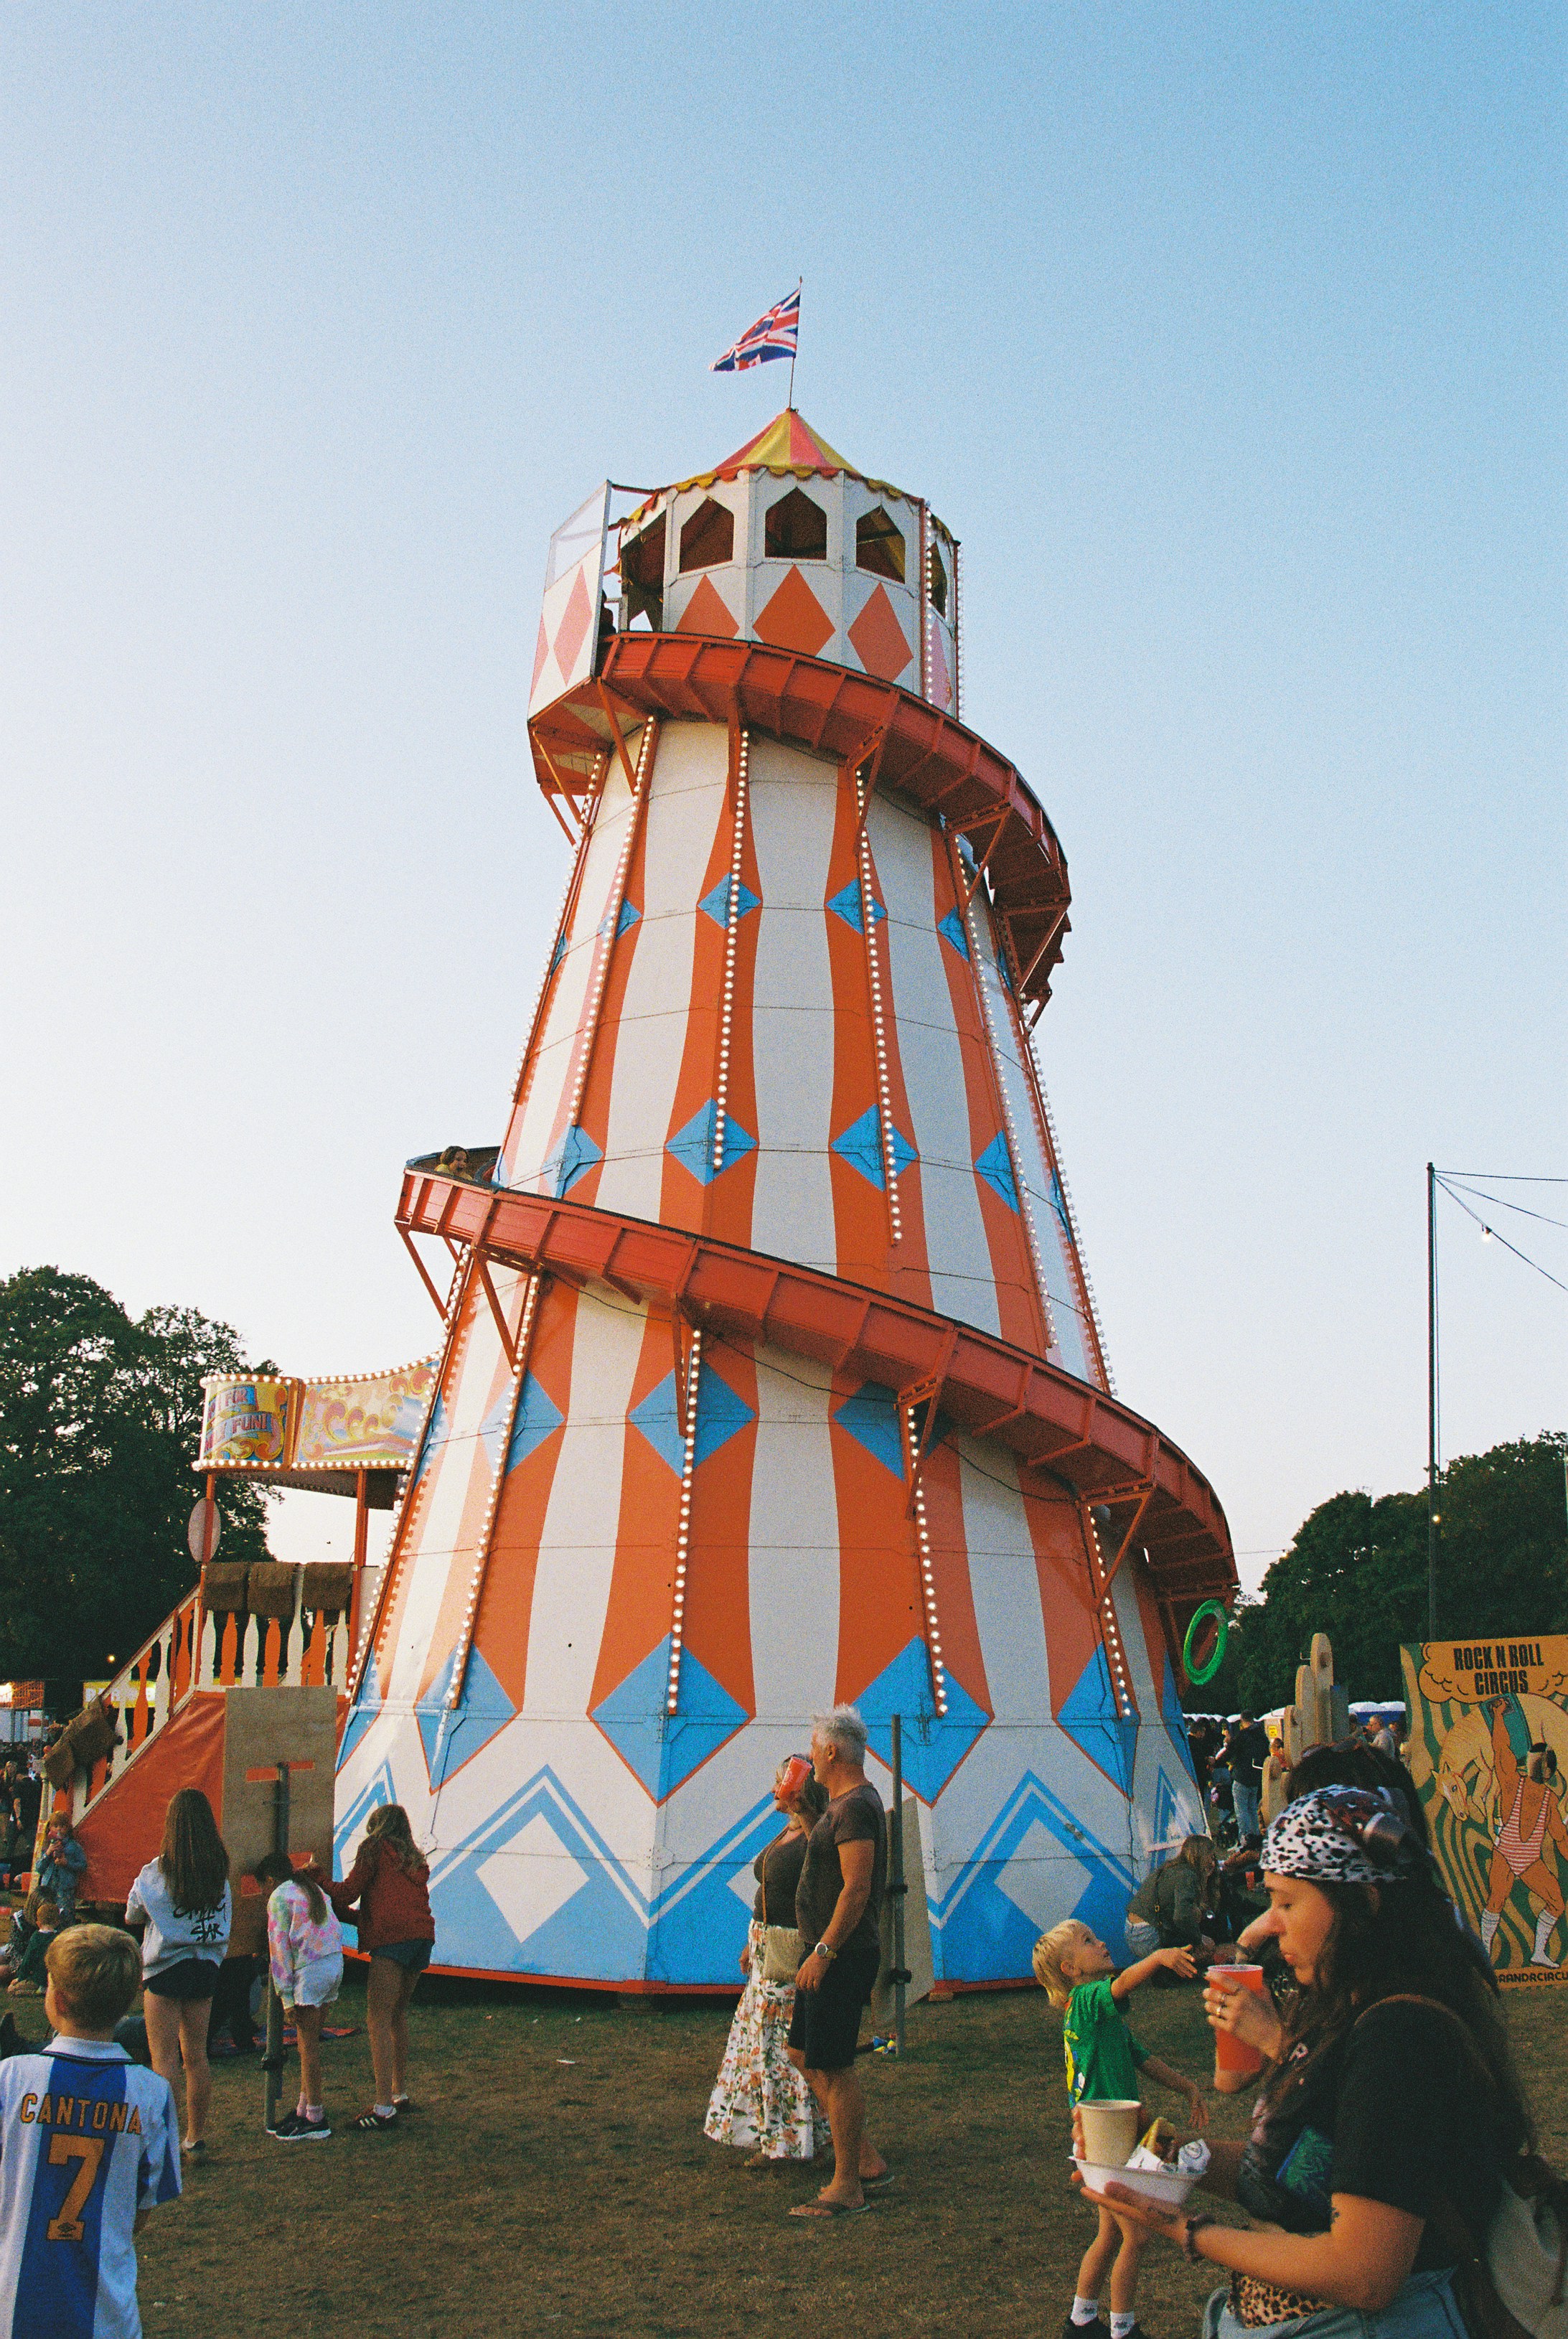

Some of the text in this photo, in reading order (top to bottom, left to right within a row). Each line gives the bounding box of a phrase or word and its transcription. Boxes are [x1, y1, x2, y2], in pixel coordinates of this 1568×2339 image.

[1453, 1644, 1544, 1671] ROCK N ROLL
[1474, 1670, 1529, 1695] CIRCUS
[20, 2092, 142, 2135] CANTONA
[46, 2132, 106, 2242] 7
